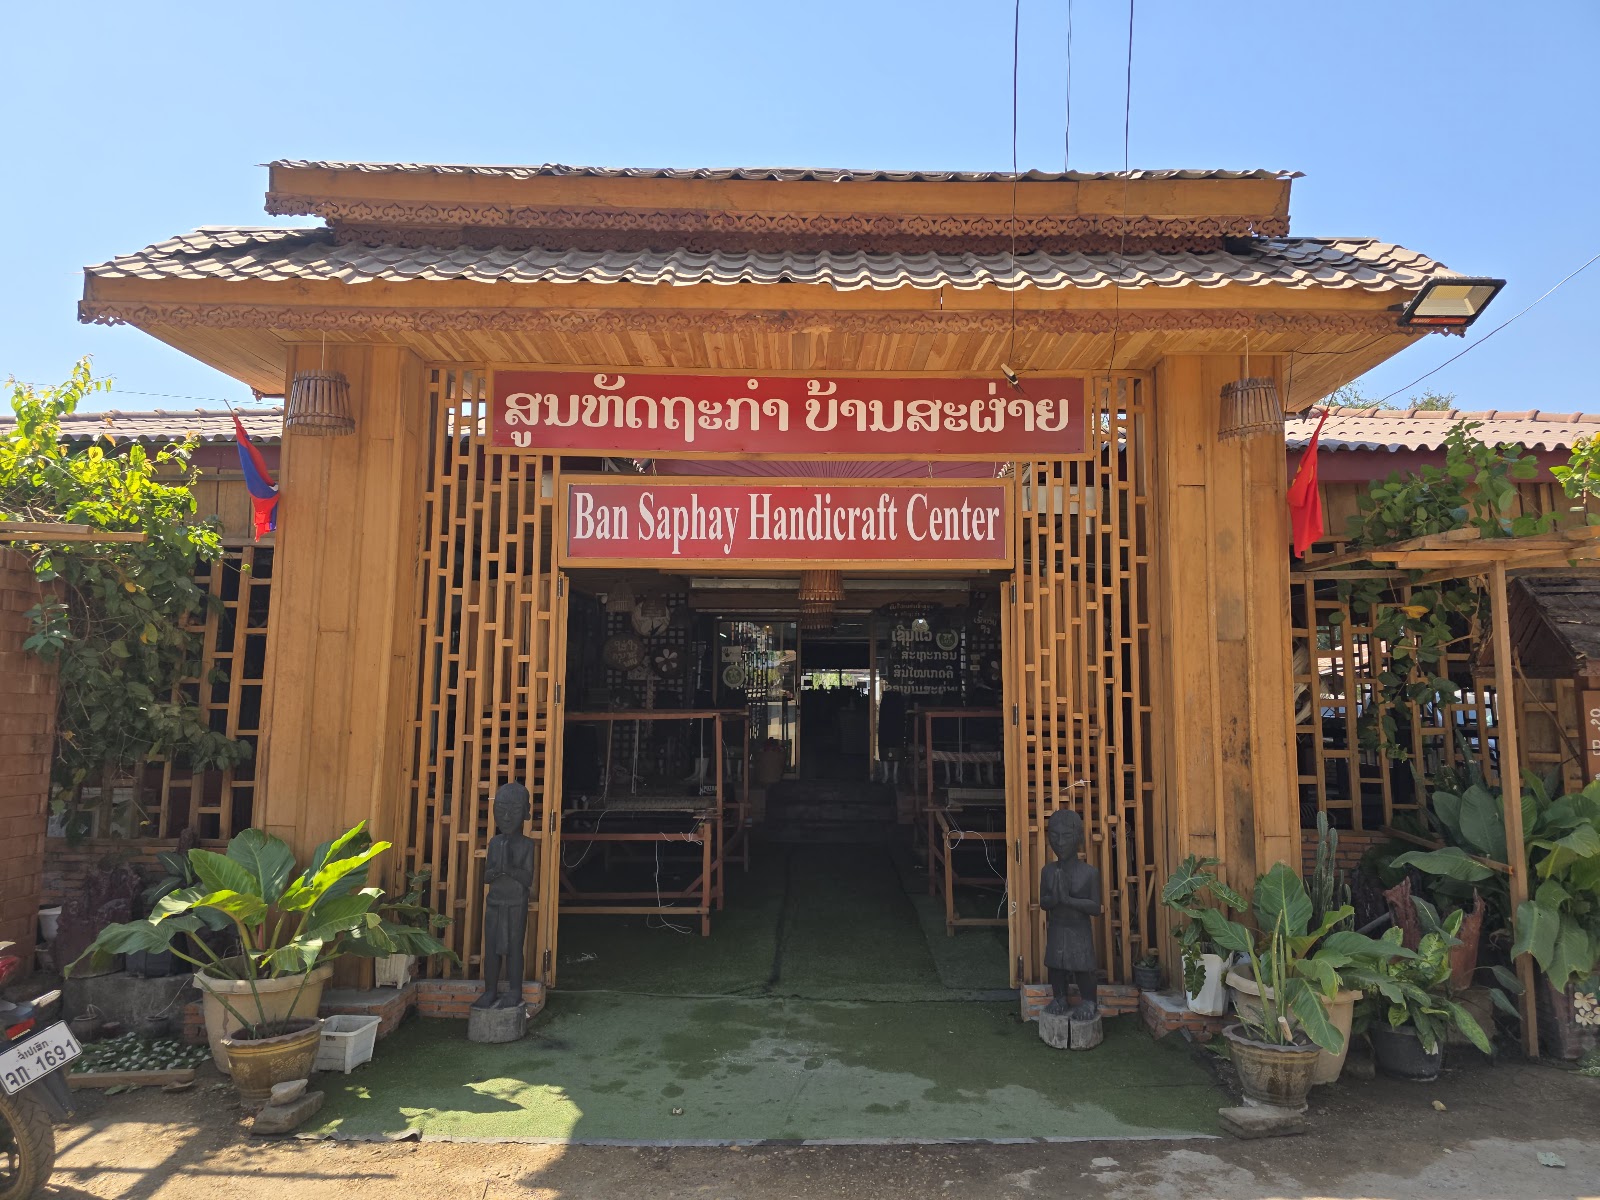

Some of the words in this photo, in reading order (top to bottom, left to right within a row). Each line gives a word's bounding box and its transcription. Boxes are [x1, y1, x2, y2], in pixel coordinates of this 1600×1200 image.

[573, 491, 629, 542] Ban
[638, 491, 740, 555] Saphay
[747, 491, 898, 542] Handicraft
[906, 492, 1001, 542] Center
[36, 1039, 77, 1071] 1691
